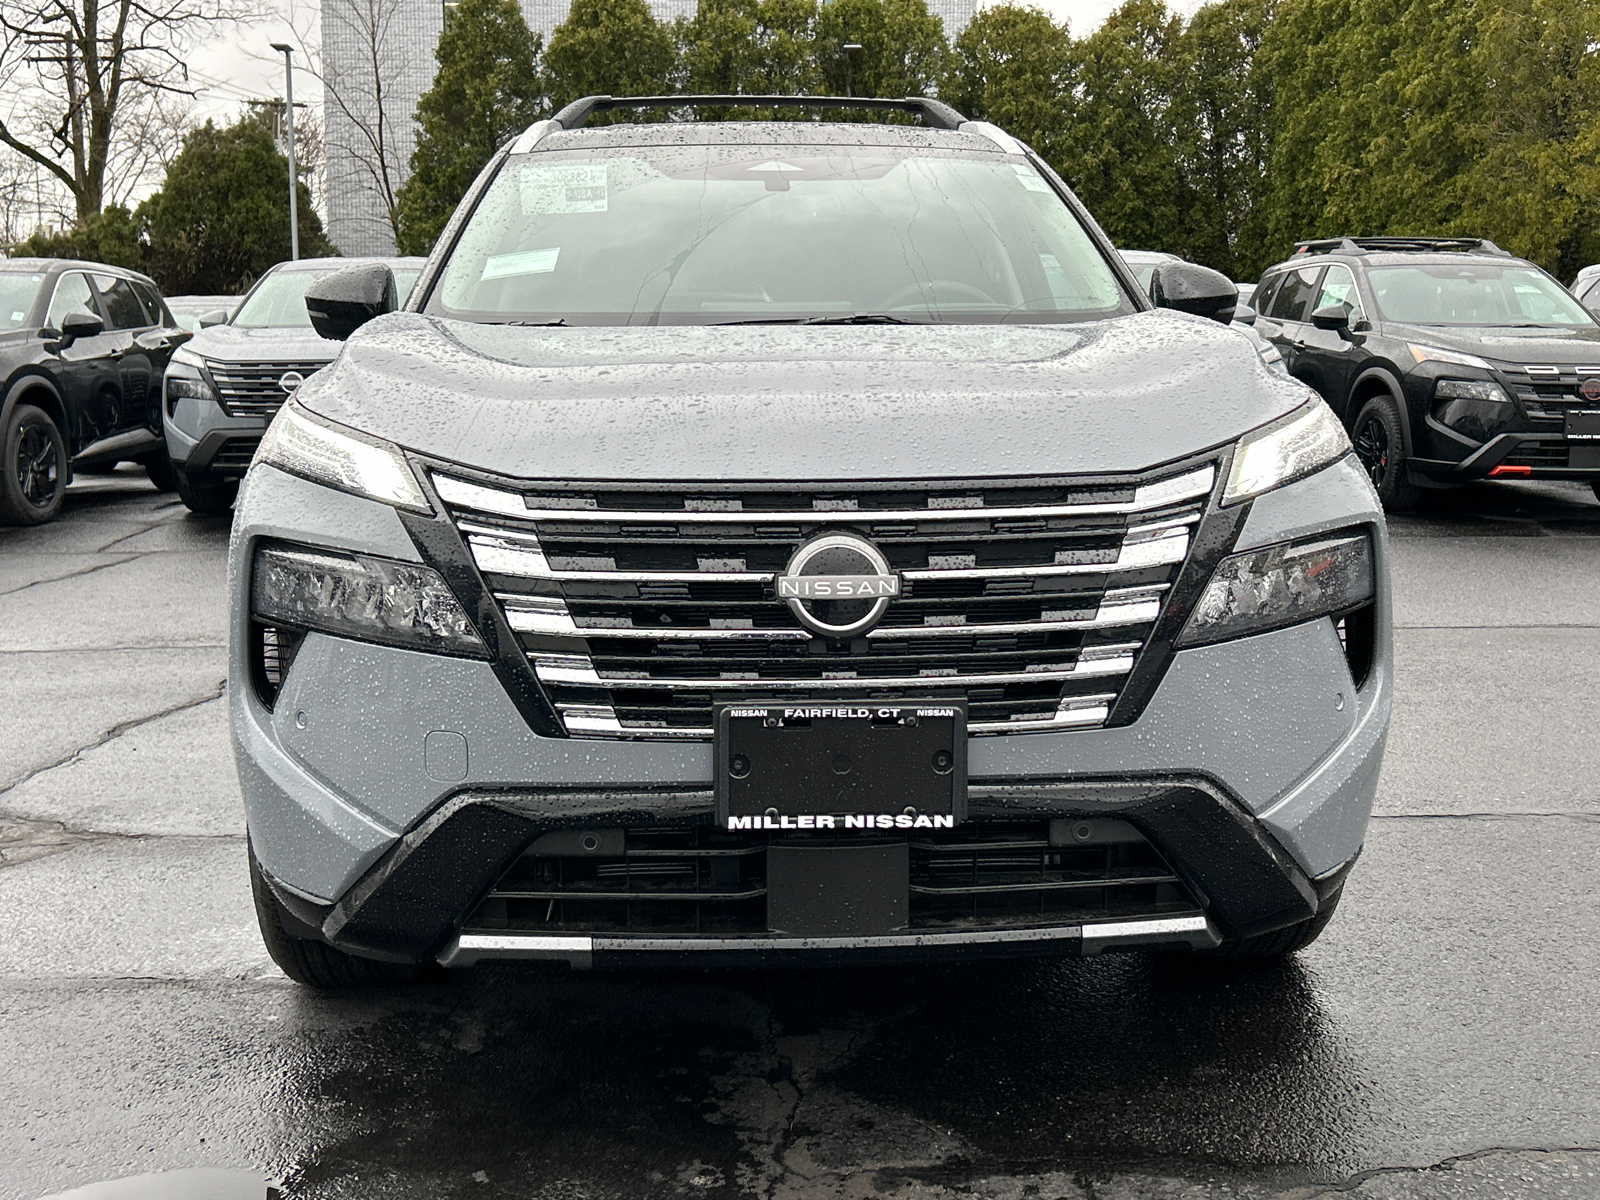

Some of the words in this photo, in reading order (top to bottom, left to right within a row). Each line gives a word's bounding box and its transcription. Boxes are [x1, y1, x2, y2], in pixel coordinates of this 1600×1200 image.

[574, 188, 593, 199] USA
[781, 579, 896, 595] NISSAN
[730, 709, 768, 717] NISSAN
[784, 708, 873, 719] FAIRFIELD,
[877, 708, 901, 718] CT
[916, 709, 954, 717] NISSAN
[728, 815, 835, 829] MILLER
[844, 814, 954, 828] NISSAN
